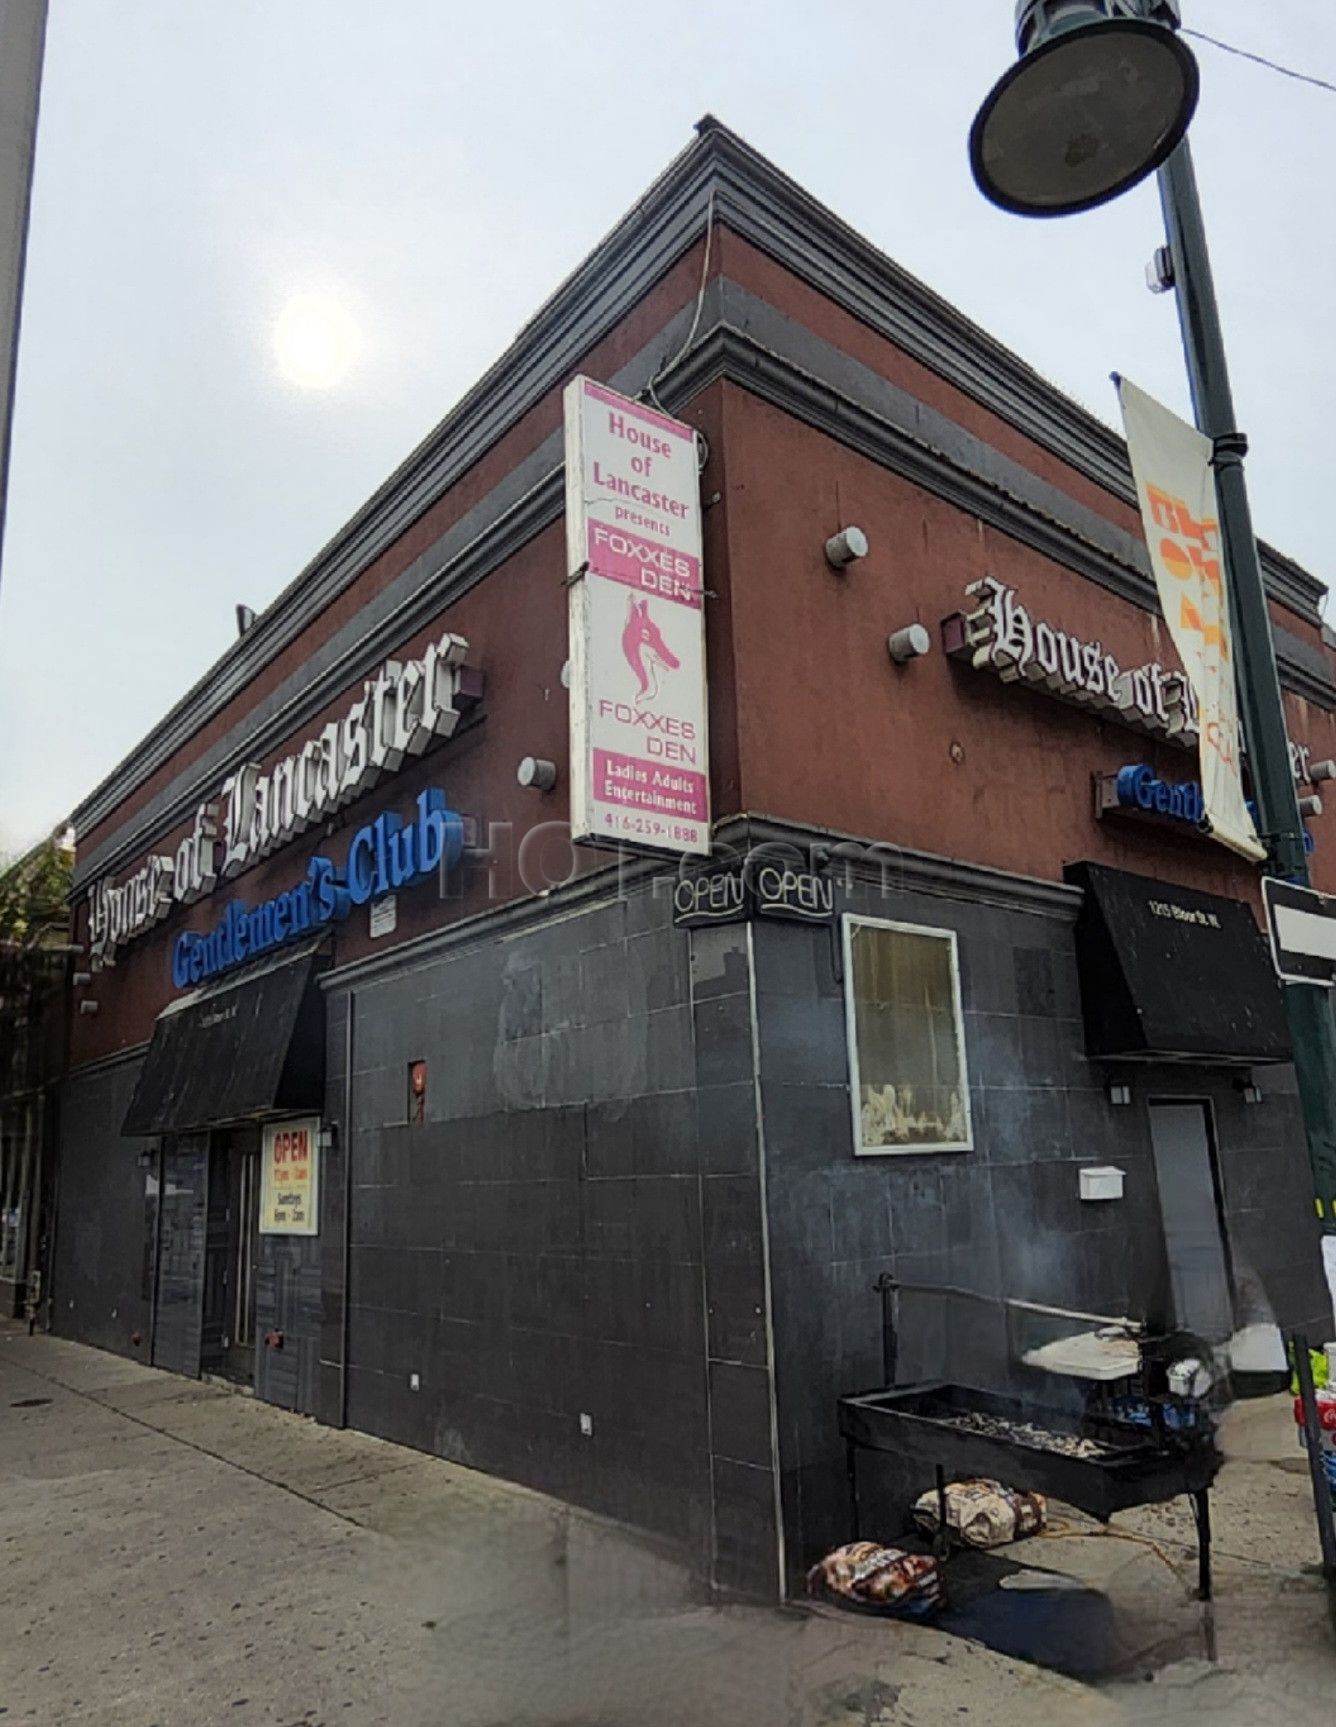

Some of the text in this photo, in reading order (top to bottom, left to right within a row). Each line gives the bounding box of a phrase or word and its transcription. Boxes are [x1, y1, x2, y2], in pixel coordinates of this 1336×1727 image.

[609, 412, 672, 459] House
[631, 456, 652, 477] of
[593, 461, 689, 520] Lancaster
[614, 506, 671, 537] presents
[595, 527, 691, 577] FOXXES
[641, 567, 694, 601] DEN
[965, 576, 1123, 702] House
[1133, 663, 1171, 721] of
[599, 699, 696, 740] FOXXES
[174, 803, 212, 901] of
[221, 633, 467, 877] Lancaster
[647, 736, 696, 764] DEN
[604, 779, 697, 816] Entertainment
[606, 760, 694, 794] Ladies Adults
[172, 786, 463, 989] Gentlemen's Club
[675, 871, 745, 912] OPEN
[759, 867, 833, 910] OPEN
[274, 1129, 308, 1164] OPEN
